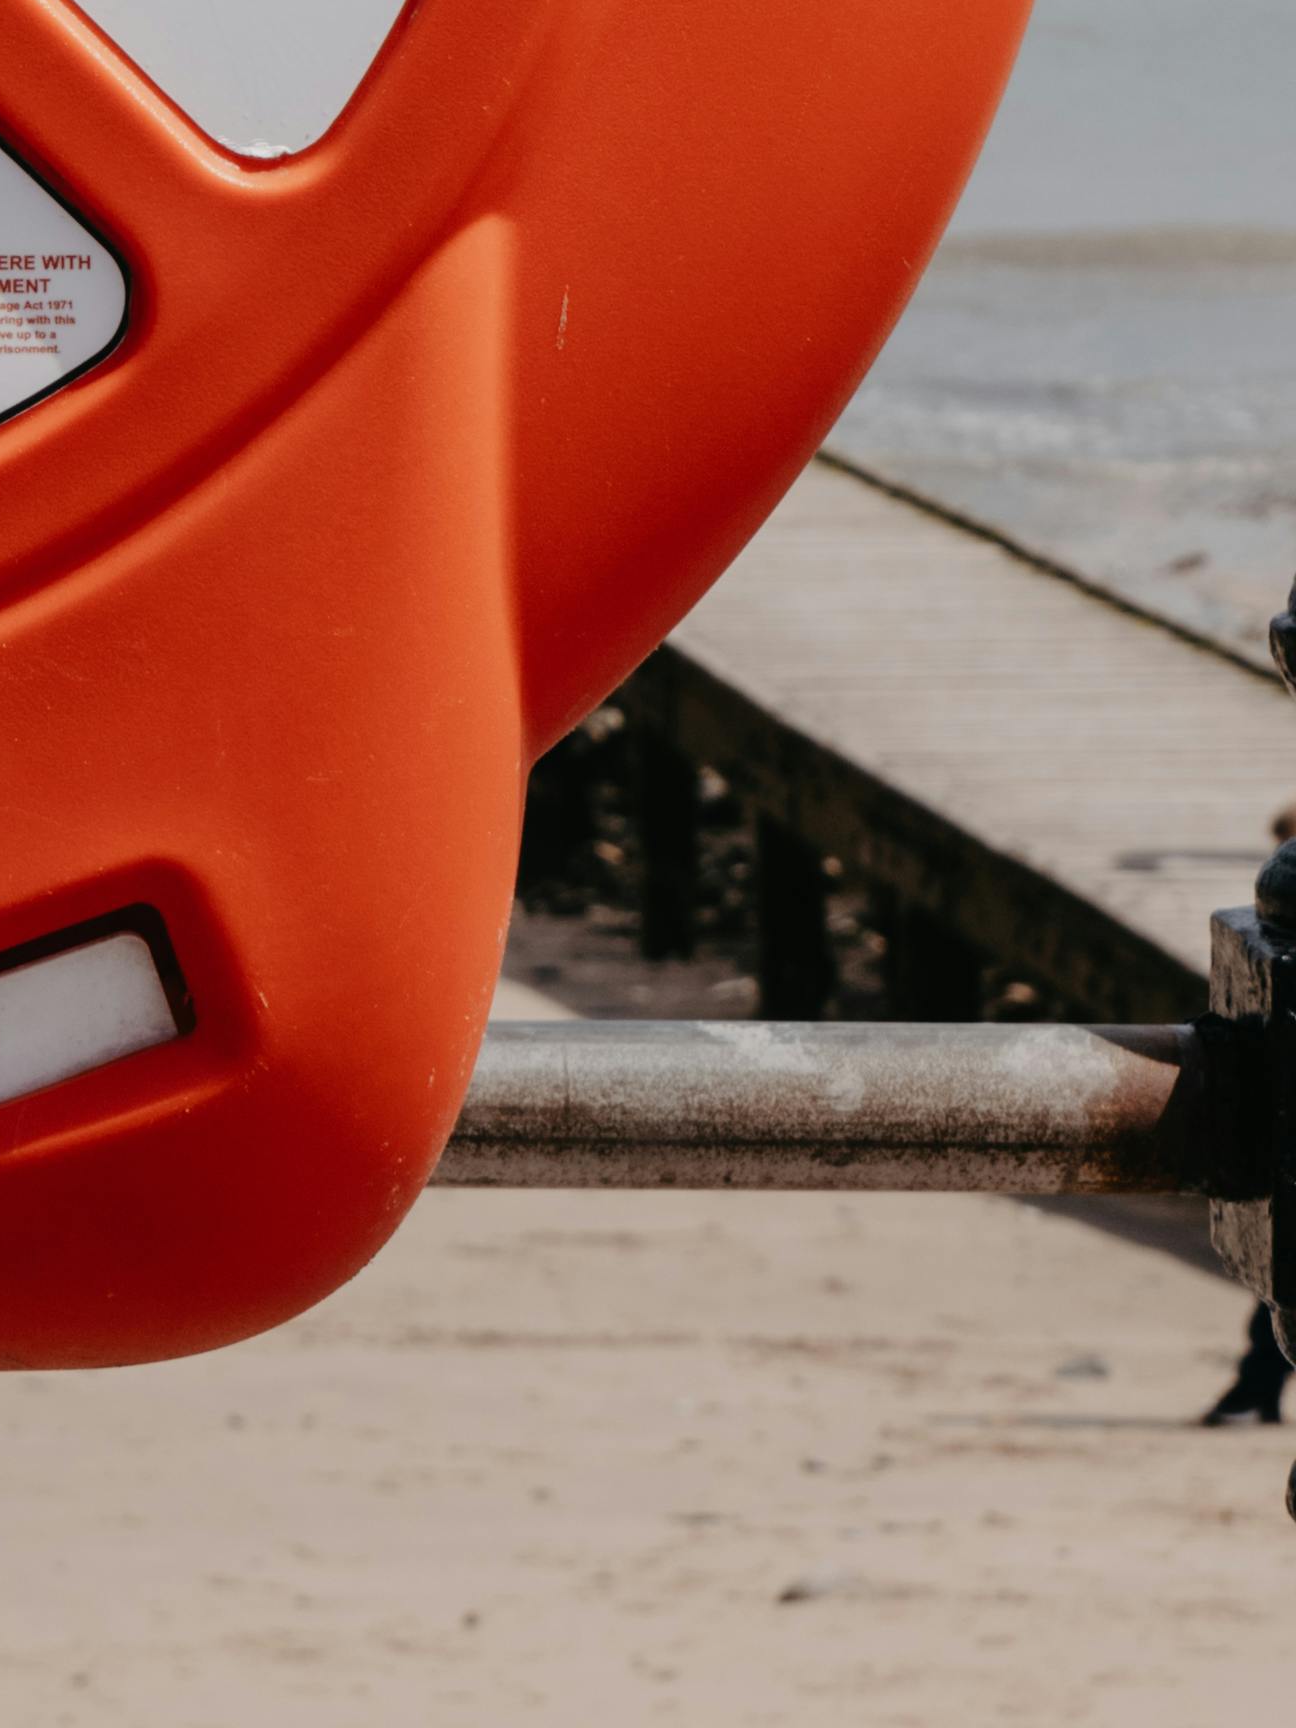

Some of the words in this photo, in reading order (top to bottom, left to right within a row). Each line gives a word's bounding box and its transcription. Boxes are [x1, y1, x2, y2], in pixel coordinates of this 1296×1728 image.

[41, 254, 92, 271] WITH
[23, 300, 44, 311] Act
[47, 299, 73, 311] 1971
[26, 314, 51, 325] with
[53, 314, 76, 325] this
[16, 331, 32, 342] up
[34, 329, 48, 340] to
[49, 331, 57, 340] a
